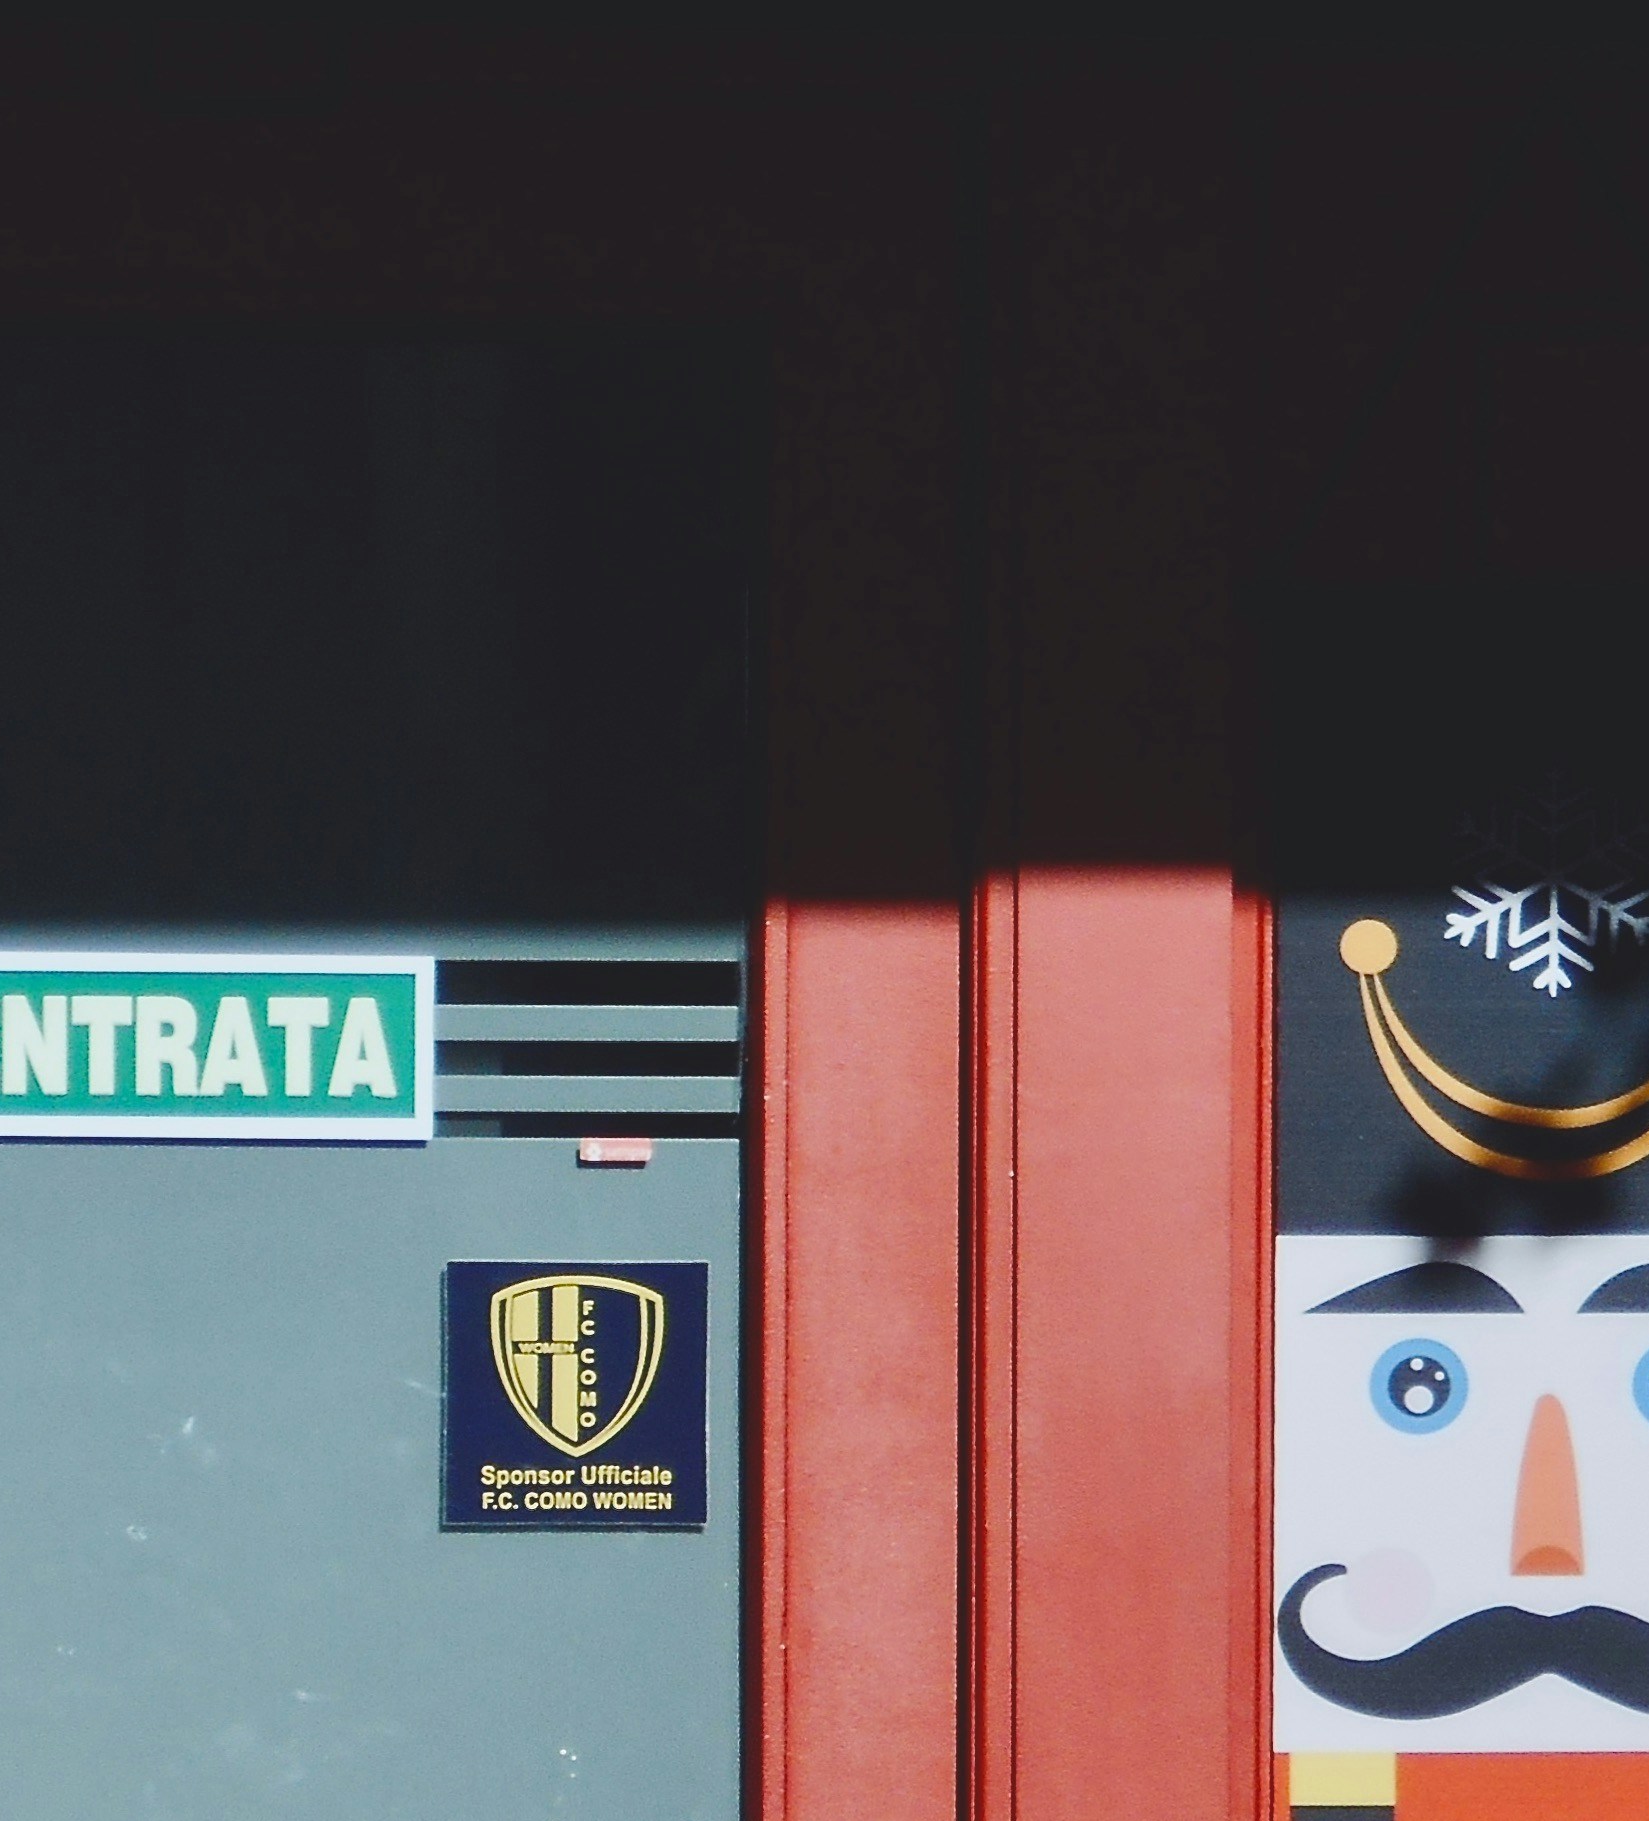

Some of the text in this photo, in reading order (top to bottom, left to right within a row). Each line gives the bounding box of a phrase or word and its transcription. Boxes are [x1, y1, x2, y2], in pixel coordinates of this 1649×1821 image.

[517, 1341, 576, 1355] WOMEN
[579, 1300, 598, 1428] FC COMO
[480, 1465, 673, 1488] Sponsor Ufficiale
[481, 1491, 673, 1511] F.C. COMO WOMEN
